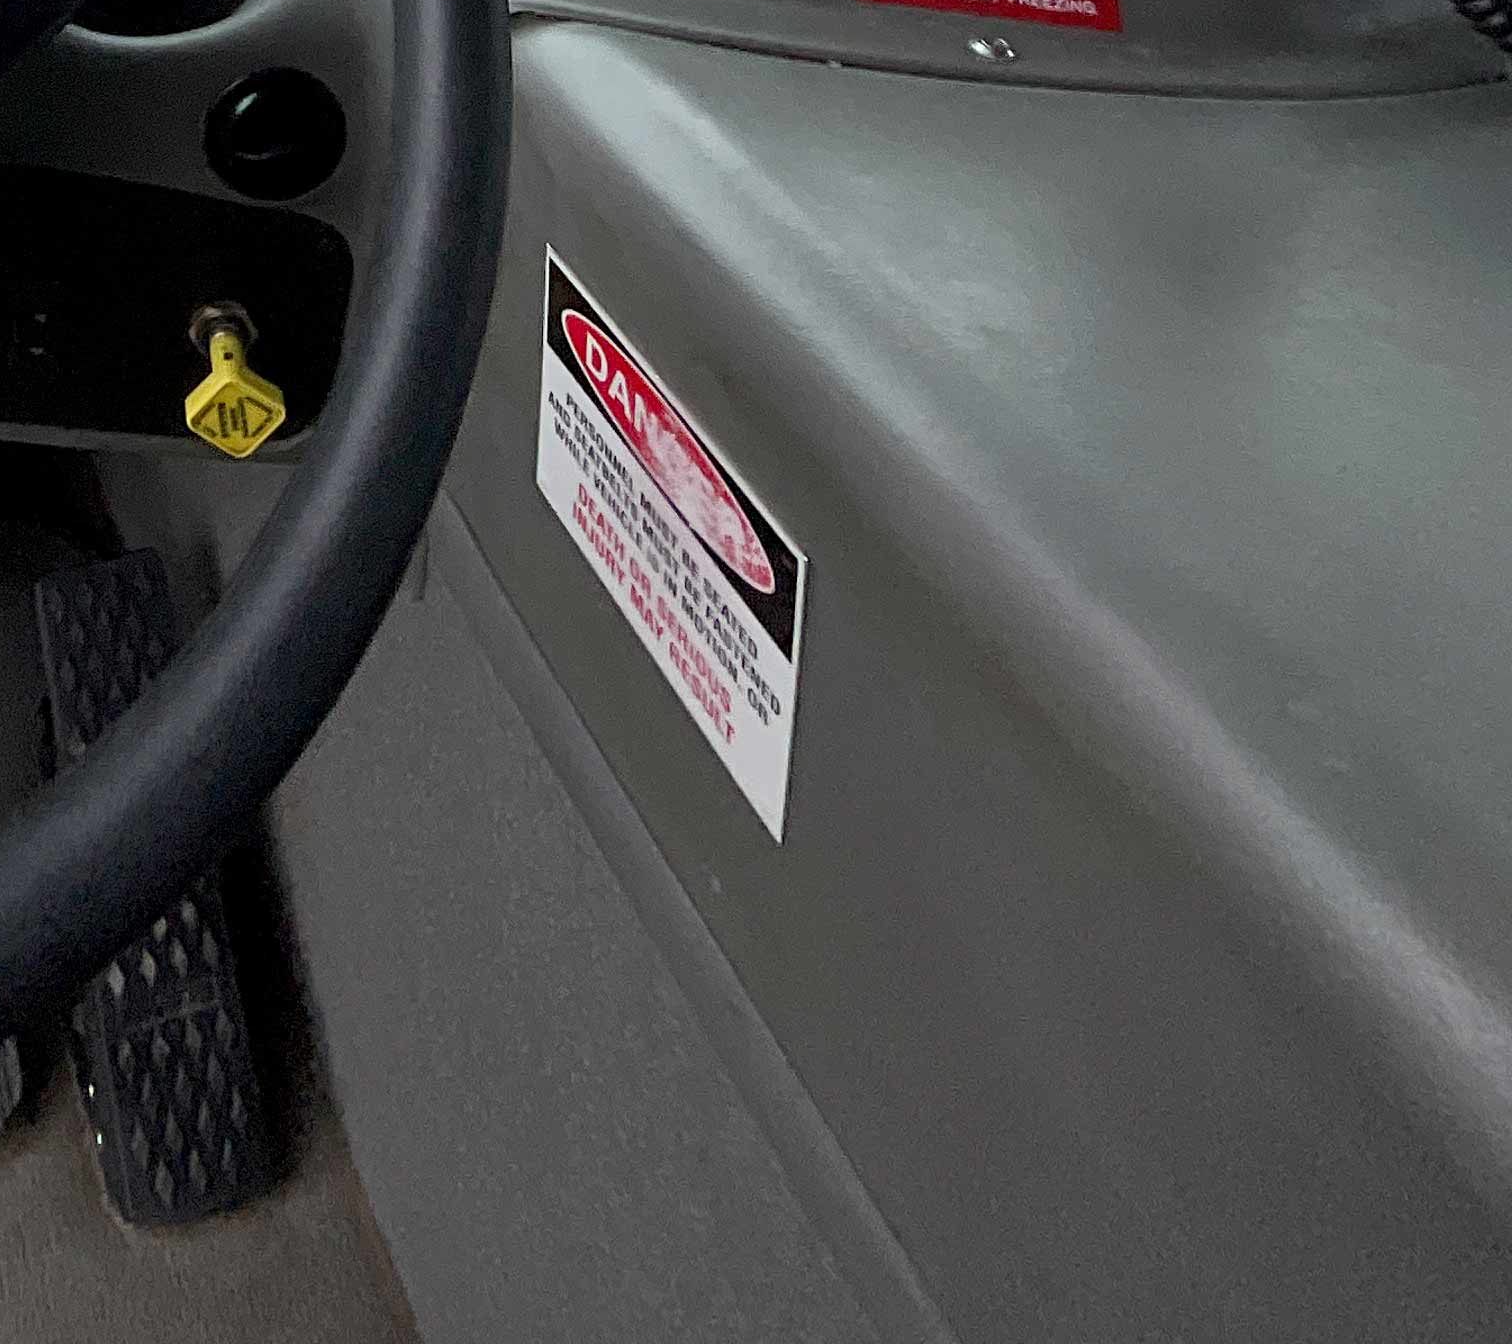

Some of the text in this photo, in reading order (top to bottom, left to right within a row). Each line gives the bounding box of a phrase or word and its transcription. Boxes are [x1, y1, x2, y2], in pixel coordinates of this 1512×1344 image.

[548, 387, 780, 720] AND SEATBELTS MUST BE FASTENED
[554, 415, 589, 479] WHILE
[593, 470, 642, 552] VEHICLE
[663, 569, 677, 601] IN
[746, 684, 769, 729] OR
[566, 388, 758, 664] PERSONNEL MUST BE SEATED
[584, 325, 748, 572] DAN
[572, 496, 735, 752] INJURY MAY RESULT
[578, 479, 731, 717] DEATH OR SERIOUS
